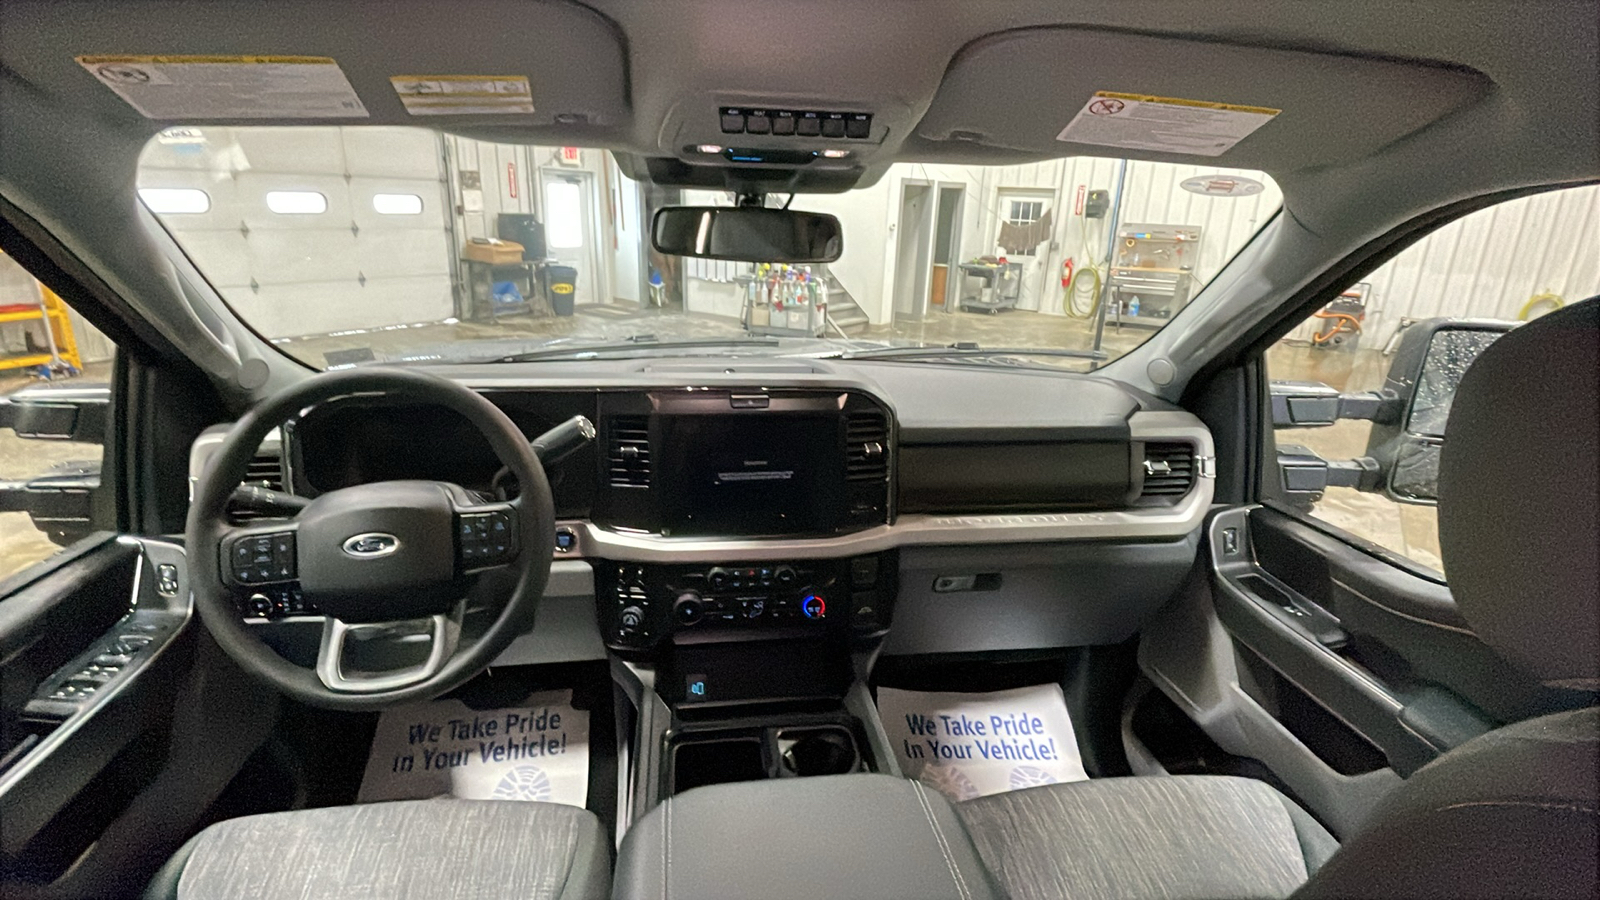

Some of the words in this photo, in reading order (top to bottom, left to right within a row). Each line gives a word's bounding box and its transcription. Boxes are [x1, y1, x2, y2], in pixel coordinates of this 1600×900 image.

[408, 724, 441, 744] We
[448, 716, 498, 740] Take
[505, 709, 561, 734] Pride
[905, 713, 937, 736] We
[940, 714, 987, 736] Take
[989, 712, 1044, 736] Pride
[423, 747, 474, 770] Your
[479, 733, 567, 763] Vehicle!
[903, 739, 925, 759] In
[927, 739, 972, 759] Your
[975, 738, 1059, 761] Vehicle!
